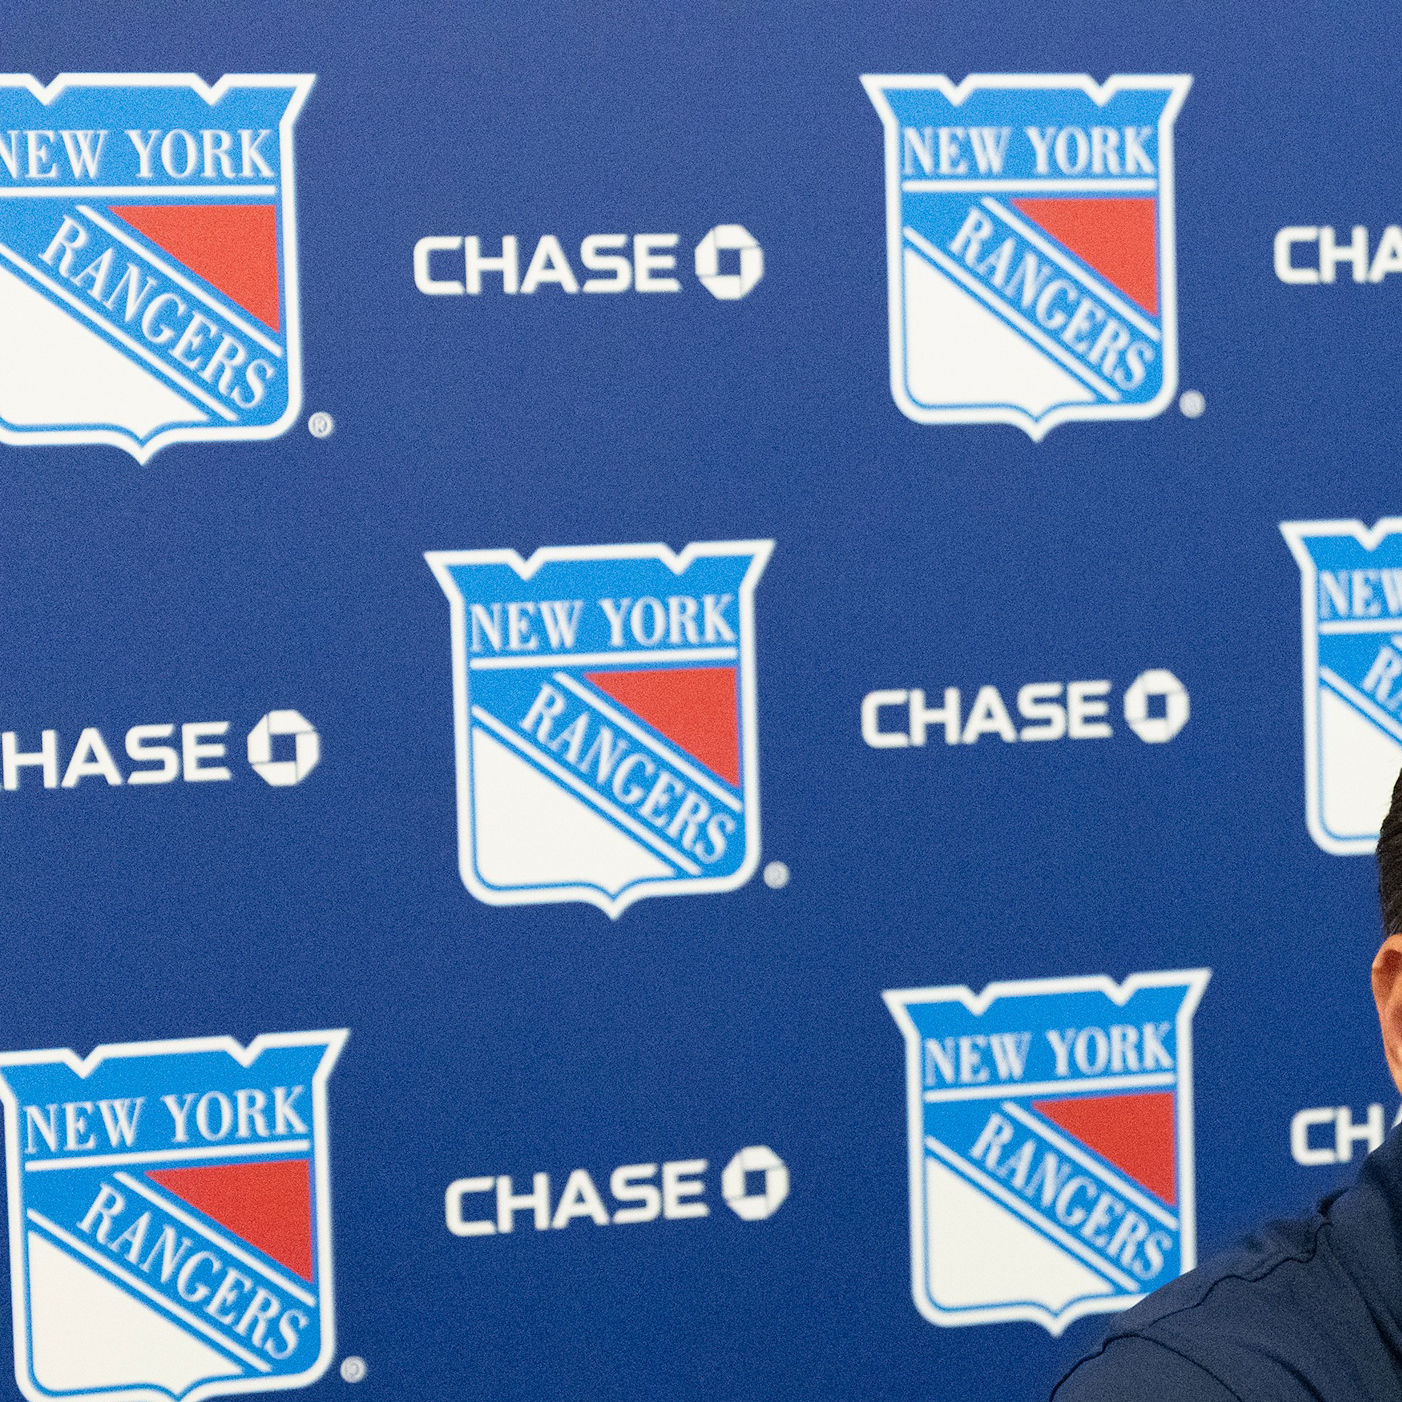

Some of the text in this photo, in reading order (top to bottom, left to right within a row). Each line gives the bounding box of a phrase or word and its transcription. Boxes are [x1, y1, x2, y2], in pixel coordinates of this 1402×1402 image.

[126, 127, 275, 181] YORK
[902, 125, 1155, 176] NEW YORK
[413, 234, 681, 295] CHASE
[948, 207, 1154, 389] RANGERS
[39, 215, 276, 409] RANGERS
[469, 594, 736, 652] NEW YORK
[862, 681, 1111, 749] CHASE
[0, 721, 231, 791] HASE
[519, 683, 736, 862] RANGERS
[924, 1022, 1174, 1085] NEW YORK
[23, 1085, 308, 1154] NEW YORK
[446, 1160, 708, 1237] CHASE
[969, 1112, 1172, 1279] RANGERS
[77, 1183, 309, 1359] RANGERS
